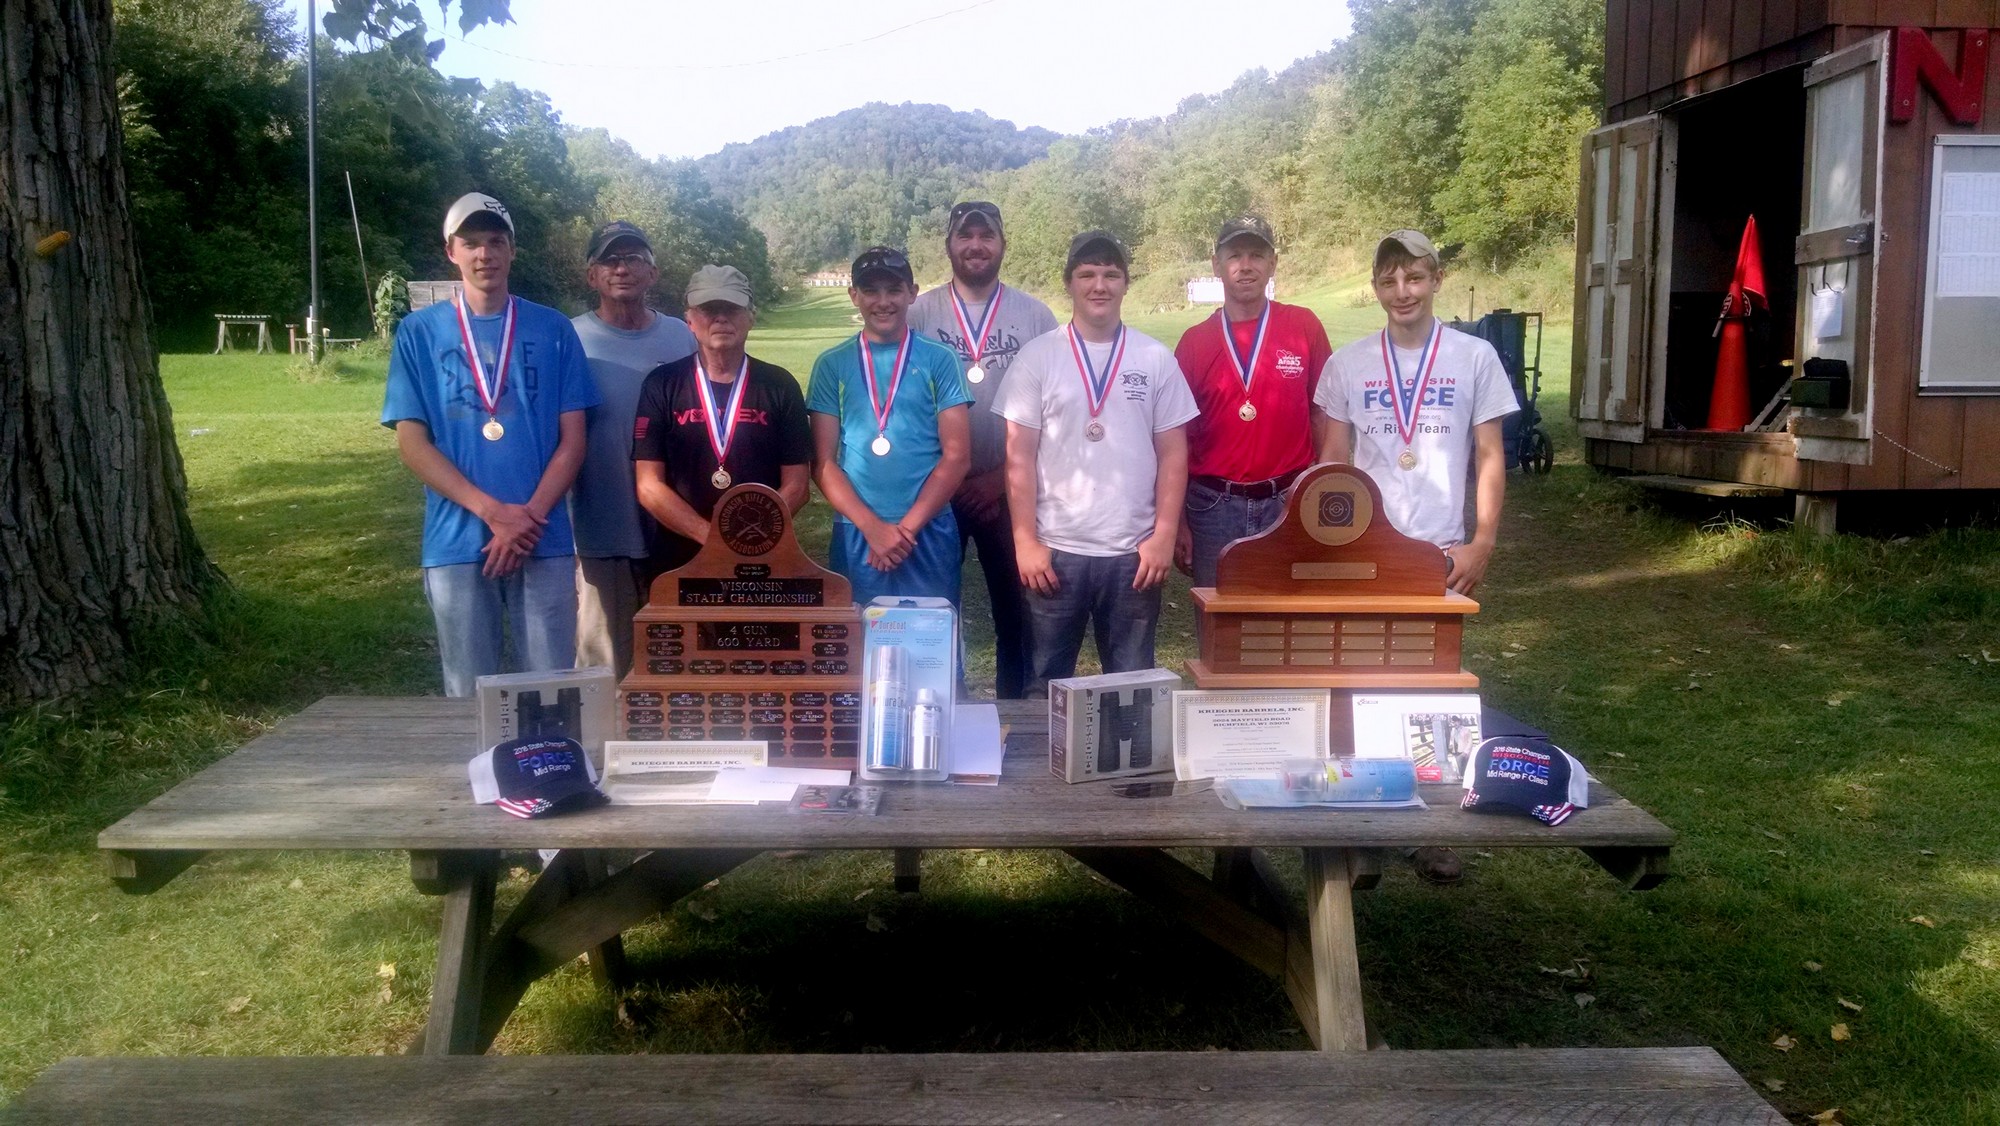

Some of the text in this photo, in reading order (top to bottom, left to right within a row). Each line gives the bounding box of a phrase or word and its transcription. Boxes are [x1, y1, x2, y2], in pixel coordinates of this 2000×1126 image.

[1893, 28, 1988, 122] N
[1365, 378, 1456, 388] WISOSIN
[671, 408, 768, 425] VOEX
[1364, 425, 1378, 434] Jr.
[1417, 423, 1451, 434] Team
[745, 494, 765, 504] RIFLE
[729, 539, 774, 554] ASSOCIATION
[720, 582, 783, 591] WISCONSIN
[686, 594, 816, 603] STATE CHAMPIONSHIP
[730, 626, 767, 635] 4 GUN
[717, 638, 780, 647] 600 YARD
[1492, 752, 1550, 766] WISCONSIN
[1522, 748, 1550, 760] Champion
[518, 752, 576, 772] FORCE
[533, 767, 548, 776] Mid
[1490, 759, 1549, 778] FORCE
[1498, 771, 1521, 779] Range
[1528, 775, 1548, 785] Class
